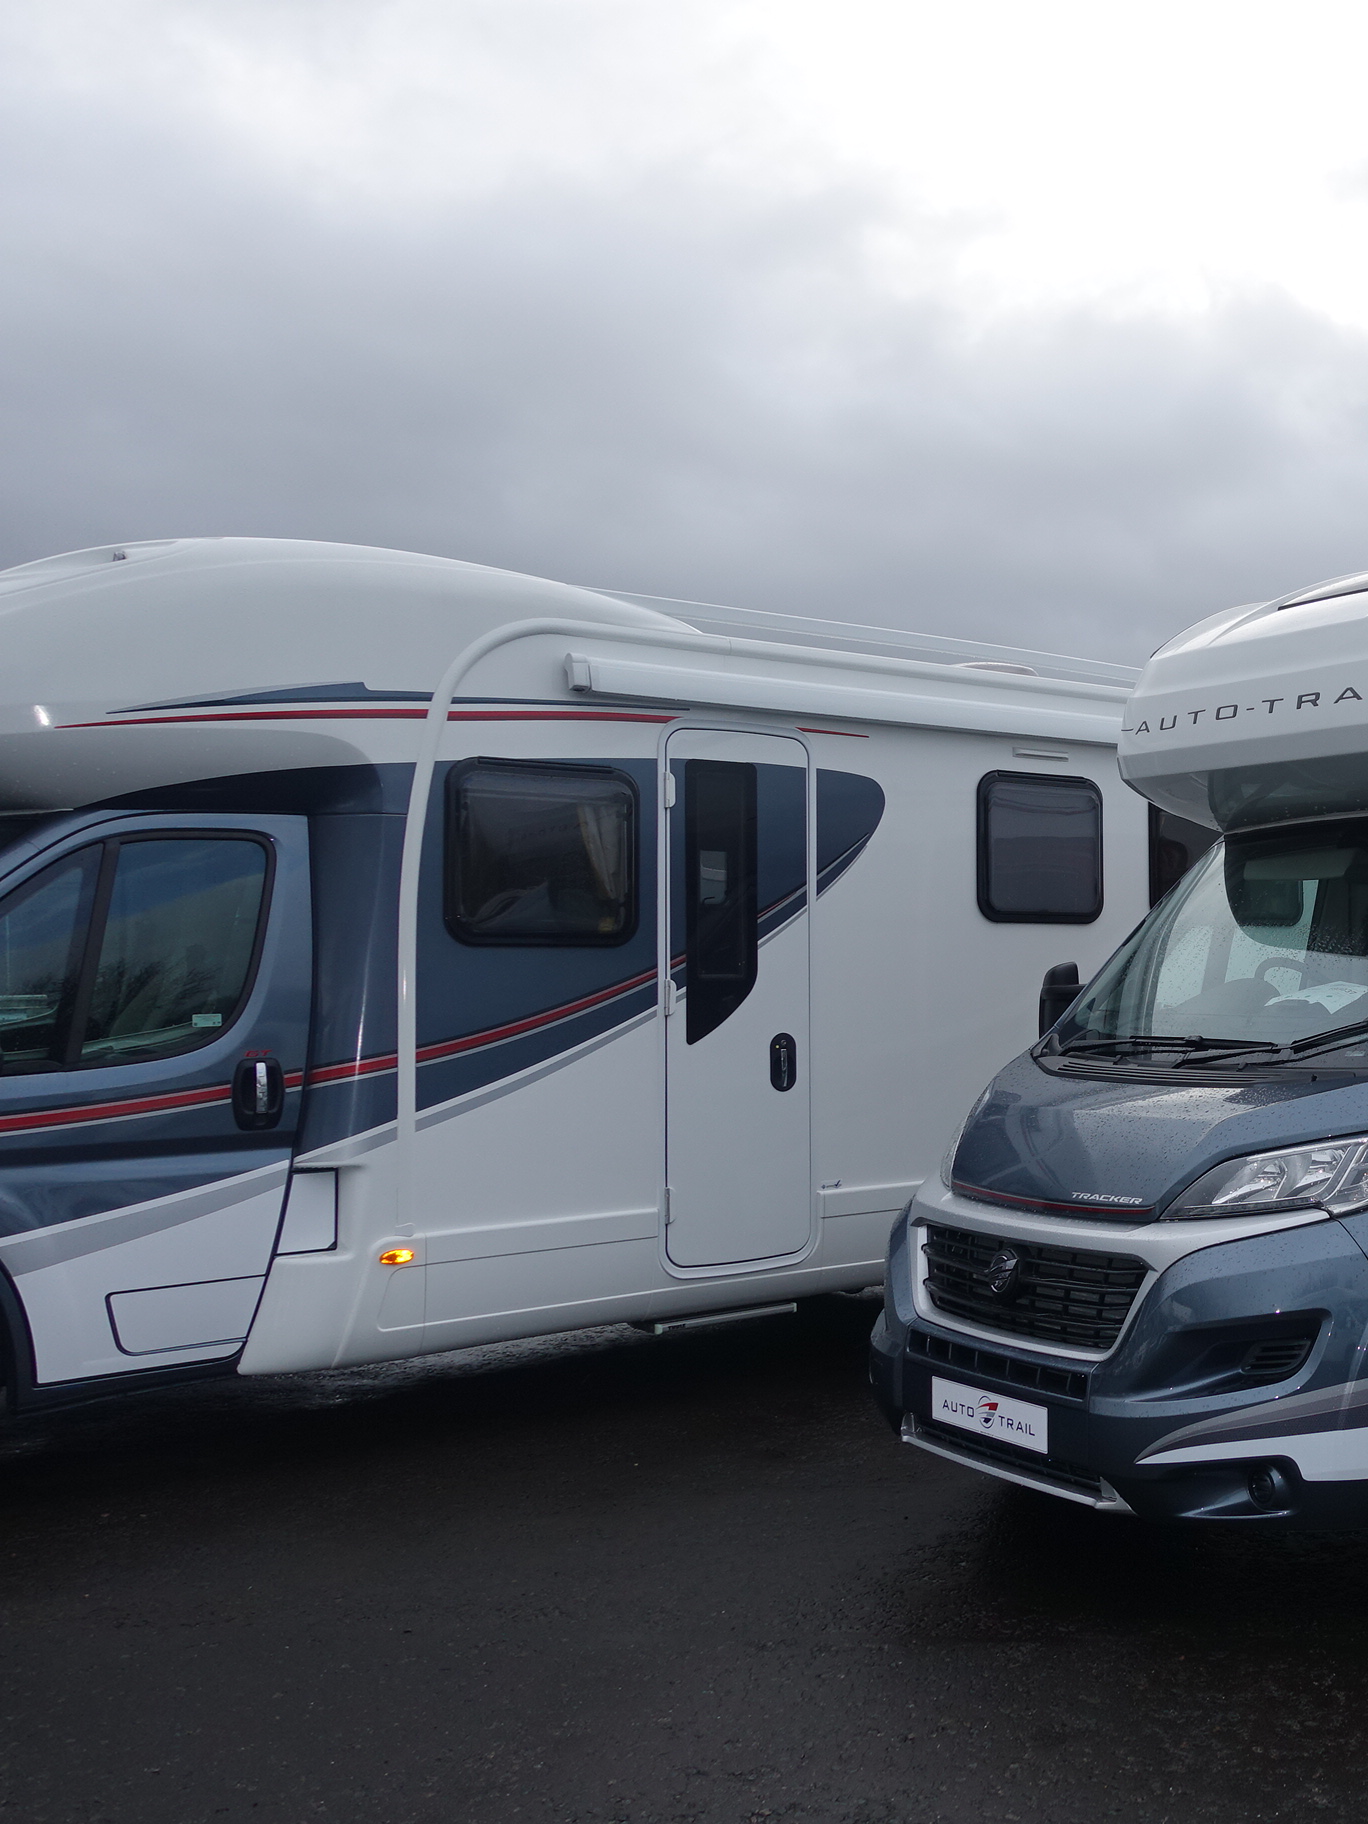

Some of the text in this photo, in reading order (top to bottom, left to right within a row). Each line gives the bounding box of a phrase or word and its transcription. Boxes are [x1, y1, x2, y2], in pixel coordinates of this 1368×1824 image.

[244, 1049, 273, 1058] GT
[1071, 1191, 1143, 1205] TRACKER
[942, 1399, 1036, 1437] AUTO TRAIL
